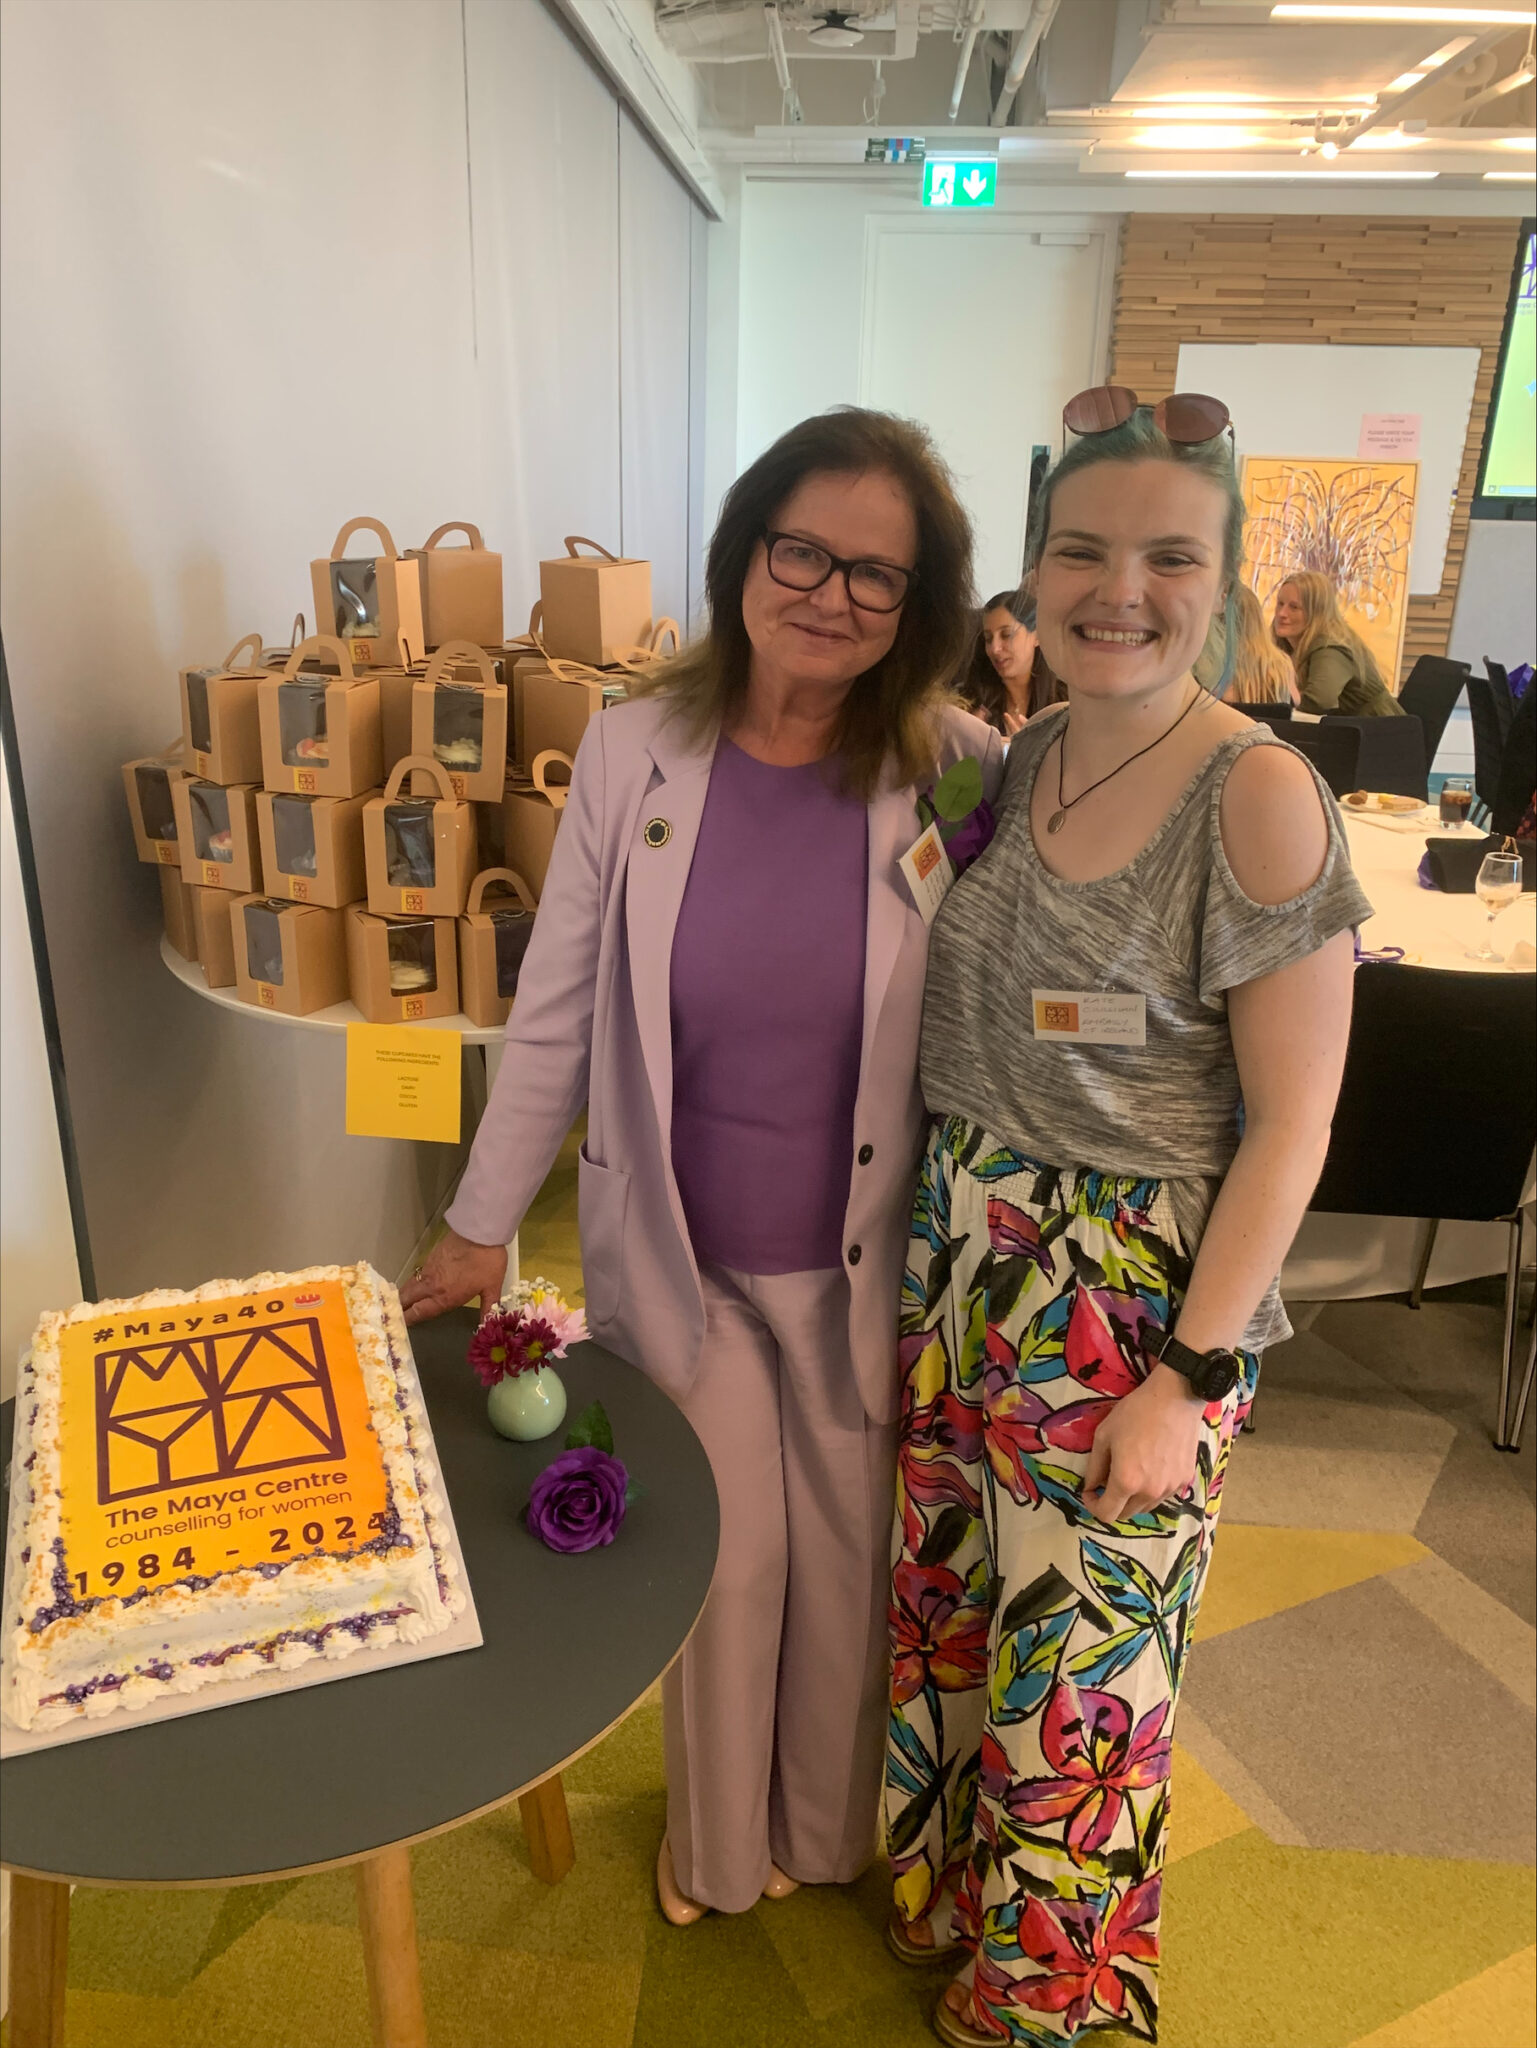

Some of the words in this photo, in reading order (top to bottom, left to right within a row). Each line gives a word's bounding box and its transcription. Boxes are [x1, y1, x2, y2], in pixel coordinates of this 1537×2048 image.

[93, 1299, 285, 1344] #Maya40
[105, 1503, 159, 1529] The
[167, 1486, 247, 1516] Maya
[255, 1471, 348, 1497] Centre
[105, 1512, 232, 1549] counselling
[238, 1505, 267, 1521] for
[271, 1489, 353, 1515] women
[74, 1546, 196, 1596] 1984
[269, 1511, 387, 1553] 2024
